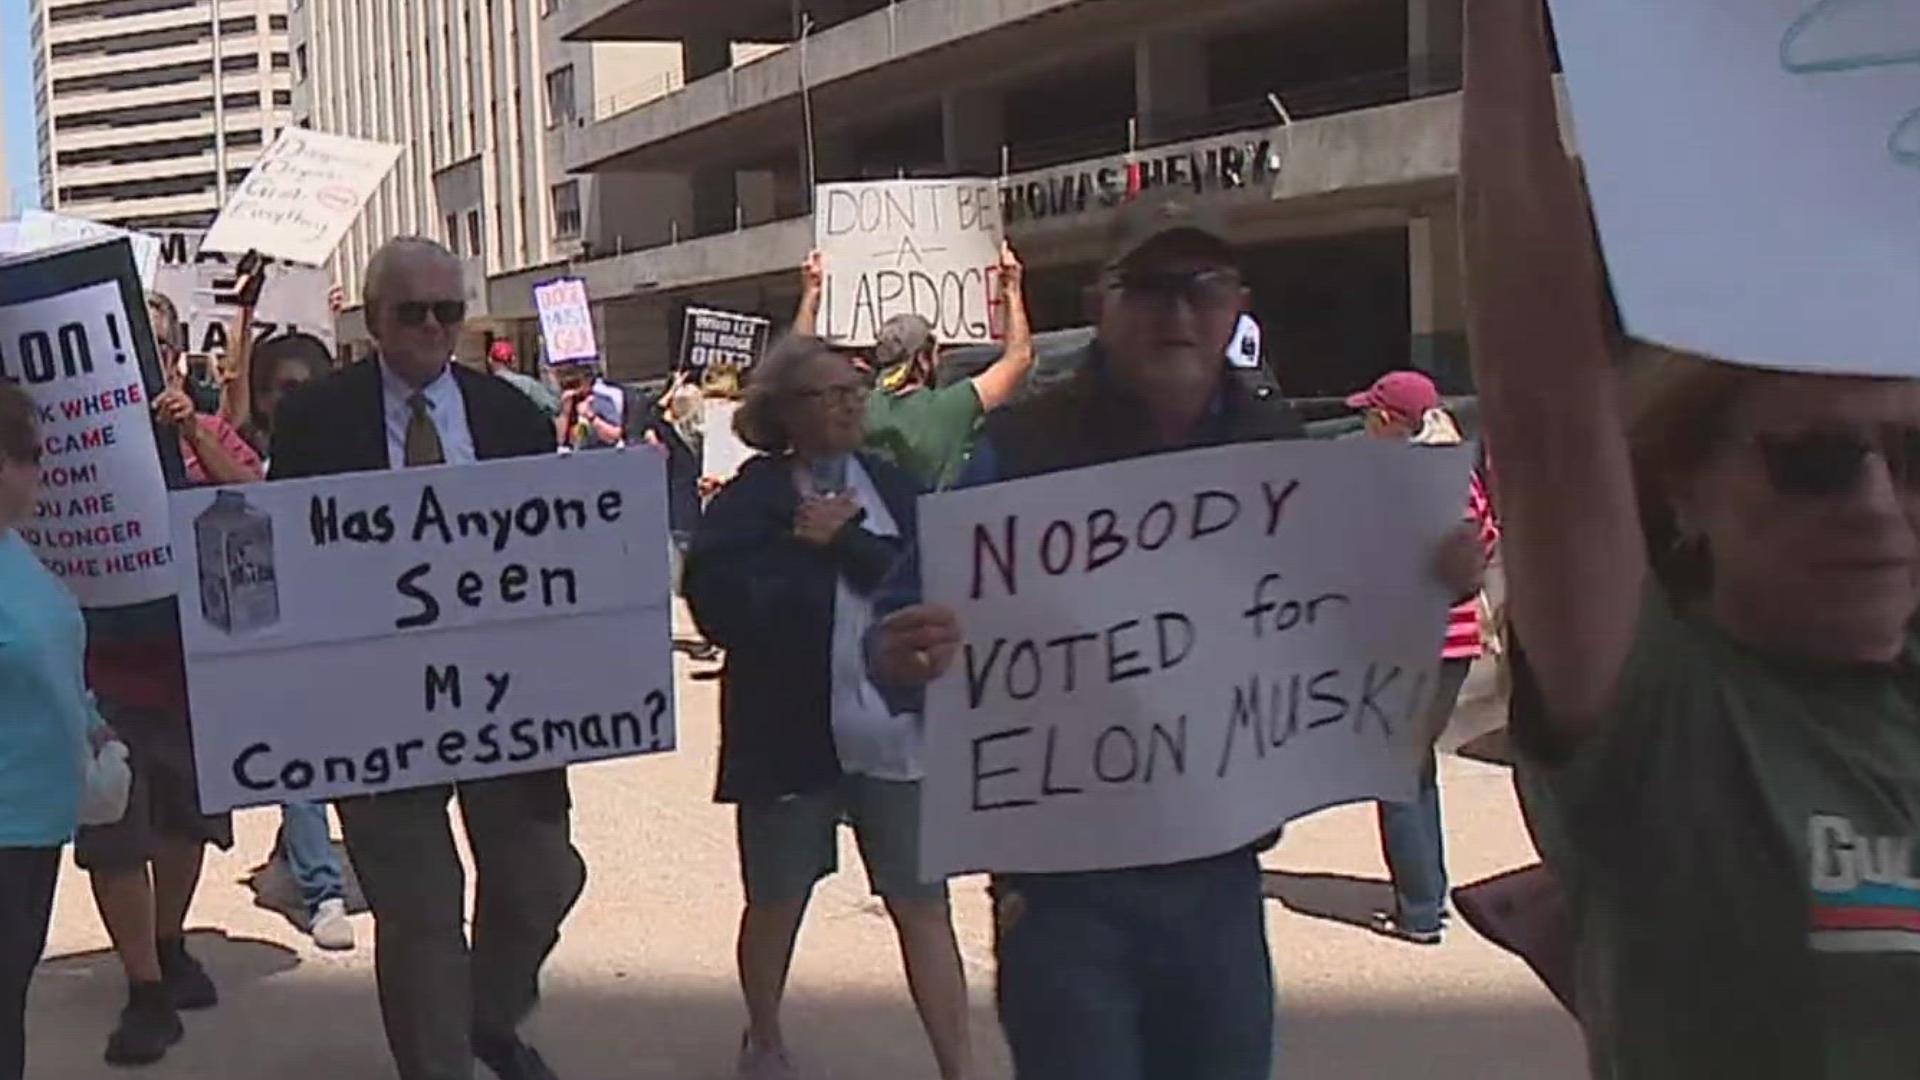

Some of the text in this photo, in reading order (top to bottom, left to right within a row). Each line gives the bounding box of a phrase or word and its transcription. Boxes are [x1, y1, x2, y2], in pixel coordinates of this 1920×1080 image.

[827, 185, 994, 236] DON'T BE
[60, 383, 142, 421] WHERE
[46, 425, 116, 456] CAME
[42, 463, 97, 487] OM!
[68, 492, 116, 517] ARE
[310, 484, 623, 552] Has Anyone
[45, 519, 142, 548] LONGER
[969, 479, 1300, 600] NOBODY
[106, 545, 174, 575] HERE!
[395, 562, 578, 629] Seen
[963, 572, 1350, 709] VOTED for
[424, 664, 511, 713] My
[232, 689, 668, 792] Congressman?
[970, 714, 1187, 812] ELON
